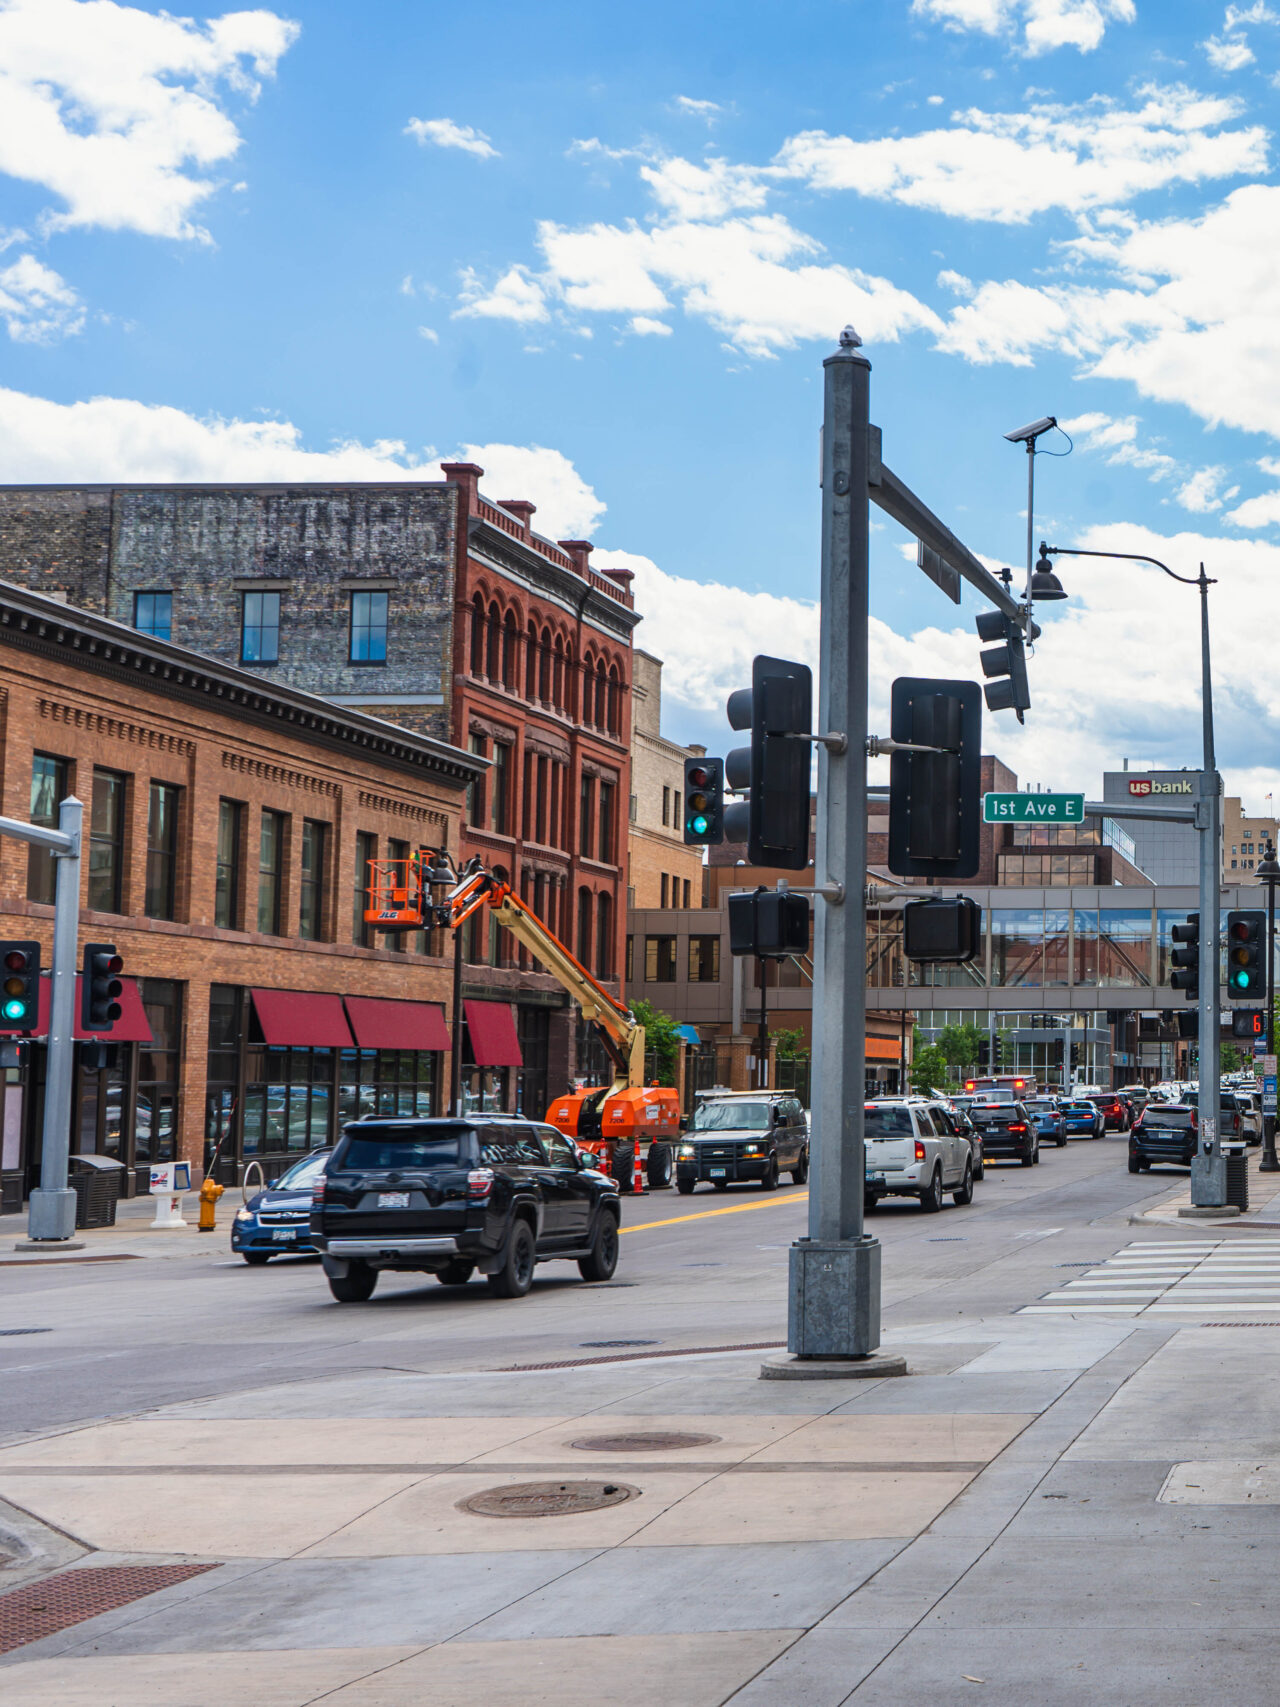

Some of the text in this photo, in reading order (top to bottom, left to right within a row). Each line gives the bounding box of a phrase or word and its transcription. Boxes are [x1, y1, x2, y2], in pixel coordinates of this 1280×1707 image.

[993, 801, 1075, 816] 1st Ave E
[379, 911, 398, 919] JLG
[1253, 1014, 1261, 1032] 6
